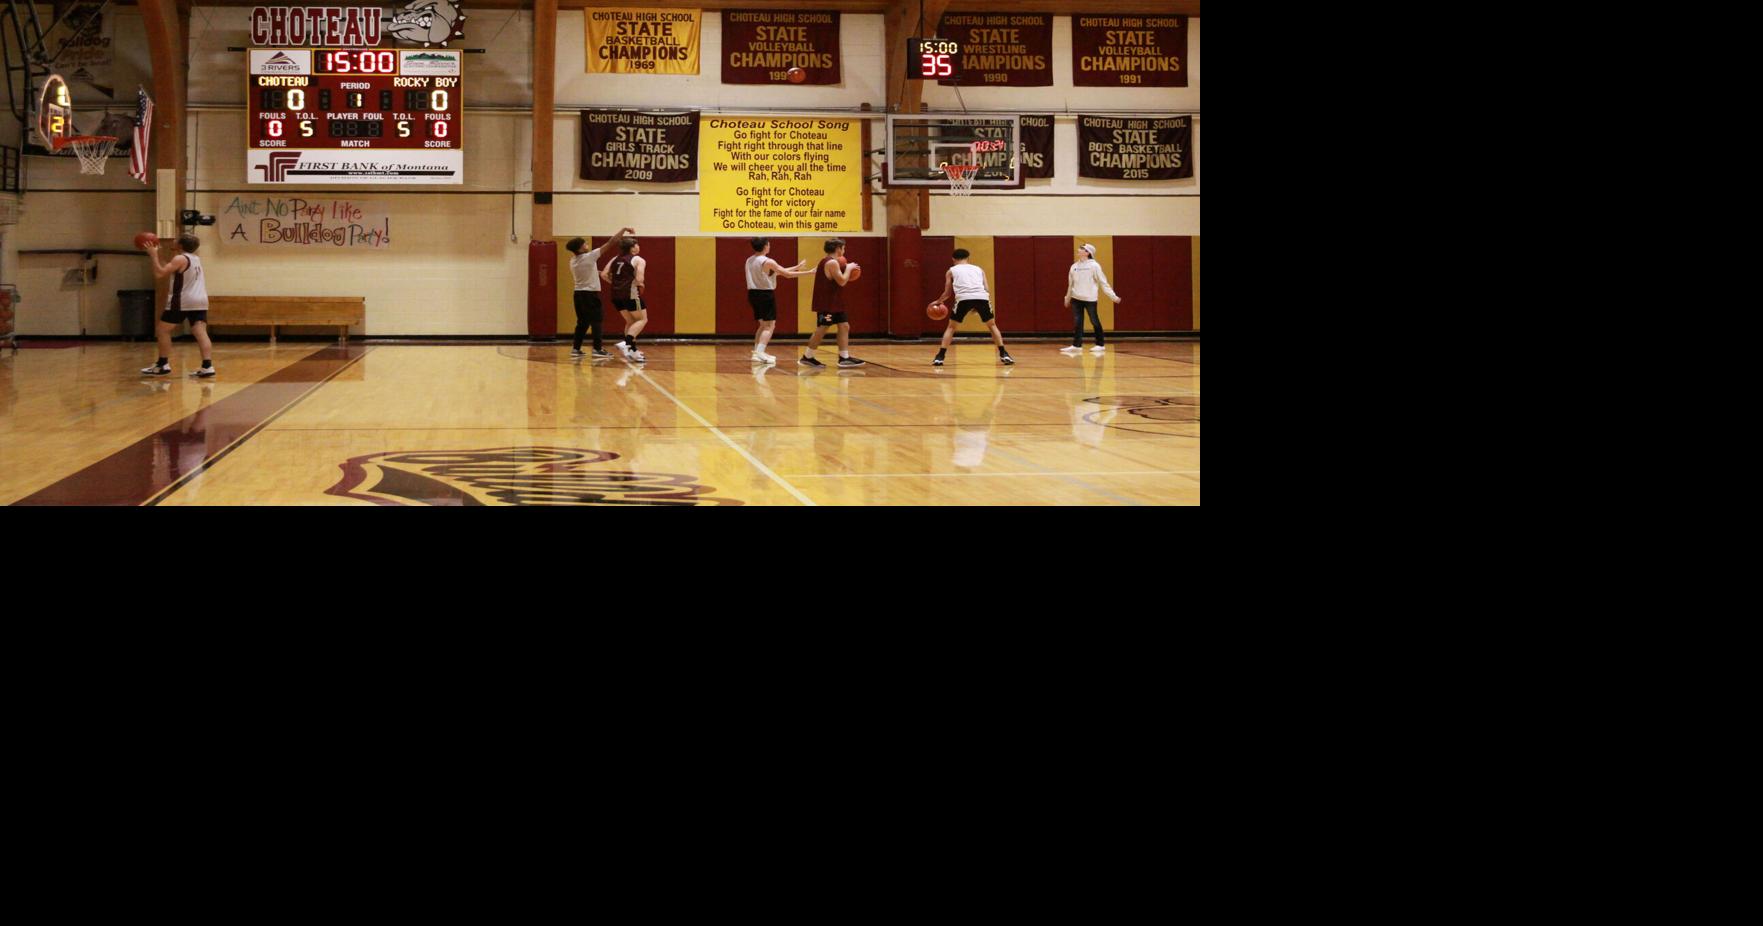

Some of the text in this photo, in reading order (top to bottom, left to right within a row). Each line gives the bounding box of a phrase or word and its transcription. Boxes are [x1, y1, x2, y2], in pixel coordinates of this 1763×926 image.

[592, 12, 695, 22] CHOTEAU HIGH SCHOOL
[730, 12, 833, 24] CHOTEAU HIGH SCHOOL
[944, 16, 1045, 25] CHOTEAU HIGH SCHOOL
[251, 6, 382, 46] CHOTEAU
[1080, 18, 1179, 28] CHOTEAU HIGH SCHOOL
[616, 22, 673, 36] STATE
[756, 26, 807, 41] STATE
[606, 36, 680, 46] BASKETBALL
[970, 29, 1019, 43] STATE
[1106, 30, 1155, 45] STATE
[599, 45, 688, 60] CHAMPIONS
[748, 42, 815, 52] VOLLEYBALL
[920, 42, 958, 54] 15:00
[963, 45, 1026, 54] WRESTLING
[1098, 46, 1162, 55] VOLLEYBALL
[326, 52, 394, 73] 15:00
[630, 60, 655, 69] 1969
[730, 52, 833, 68] CHAMPIONS
[922, 54, 952, 76] 35
[1081, 56, 1180, 71] CHAMPIONS
[258, 76, 309, 87] CHOTEAU
[393, 77, 458, 88] ROCKY BOY
[984, 73, 1008, 82] 1990
[1120, 75, 1142, 84] 1991
[340, 82, 371, 90] PERIOD
[287, 89, 305, 111] 0
[431, 90, 448, 111] 0
[259, 112, 287, 120] FOULS
[296, 112, 319, 120] T.O.L.
[327, 112, 384, 120] PLAYER FOUL
[589, 113, 693, 126] CHOTEAU HIGH SCHOOL
[268, 120, 283, 137] 0
[434, 121, 448, 138] 0
[710, 119, 850, 131] Choteau School Song
[1083, 118, 1187, 130] CHOTEAU HIGH SCHOOL
[616, 126, 666, 143] STATE
[733, 130, 828, 142] Go fight for Choteau
[1112, 129, 1158, 145] STATE
[424, 140, 452, 148] SCORE
[606, 142, 675, 154] GIRLS TRACK
[718, 141, 843, 152] Fight right through that line
[1119, 143, 1182, 154] BASKETBALL
[591, 152, 690, 170] CHAMPIONS
[731, 152, 751, 161] With
[772, 152, 801, 161] colors
[803, 152, 829, 163] flying
[1090, 152, 1182, 169] CHAMPIONS
[299, 162, 339, 170] FIRST
[341, 162, 379, 170] BANK
[713, 162, 847, 174] We will cheer you all the time
[624, 169, 653, 180] 2009
[748, 172, 812, 182] Rah, Rah, Rah
[1123, 169, 1149, 179] 2015
[736, 187, 825, 198] Go fight for Choteau
[745, 198, 816, 209] Fight for victory
[713, 208, 733, 219] Fight
[735, 208, 747, 217] for
[749, 208, 762, 217] the
[763, 208, 783, 217] fame
[784, 208, 793, 217] of
[810, 209, 823, 218] fair
[825, 210, 846, 218] name
[722, 220, 838, 231] Go Choteau, win this game
[230, 217, 390, 247] A Bulldog Party!
[616, 261, 625, 275] 7
